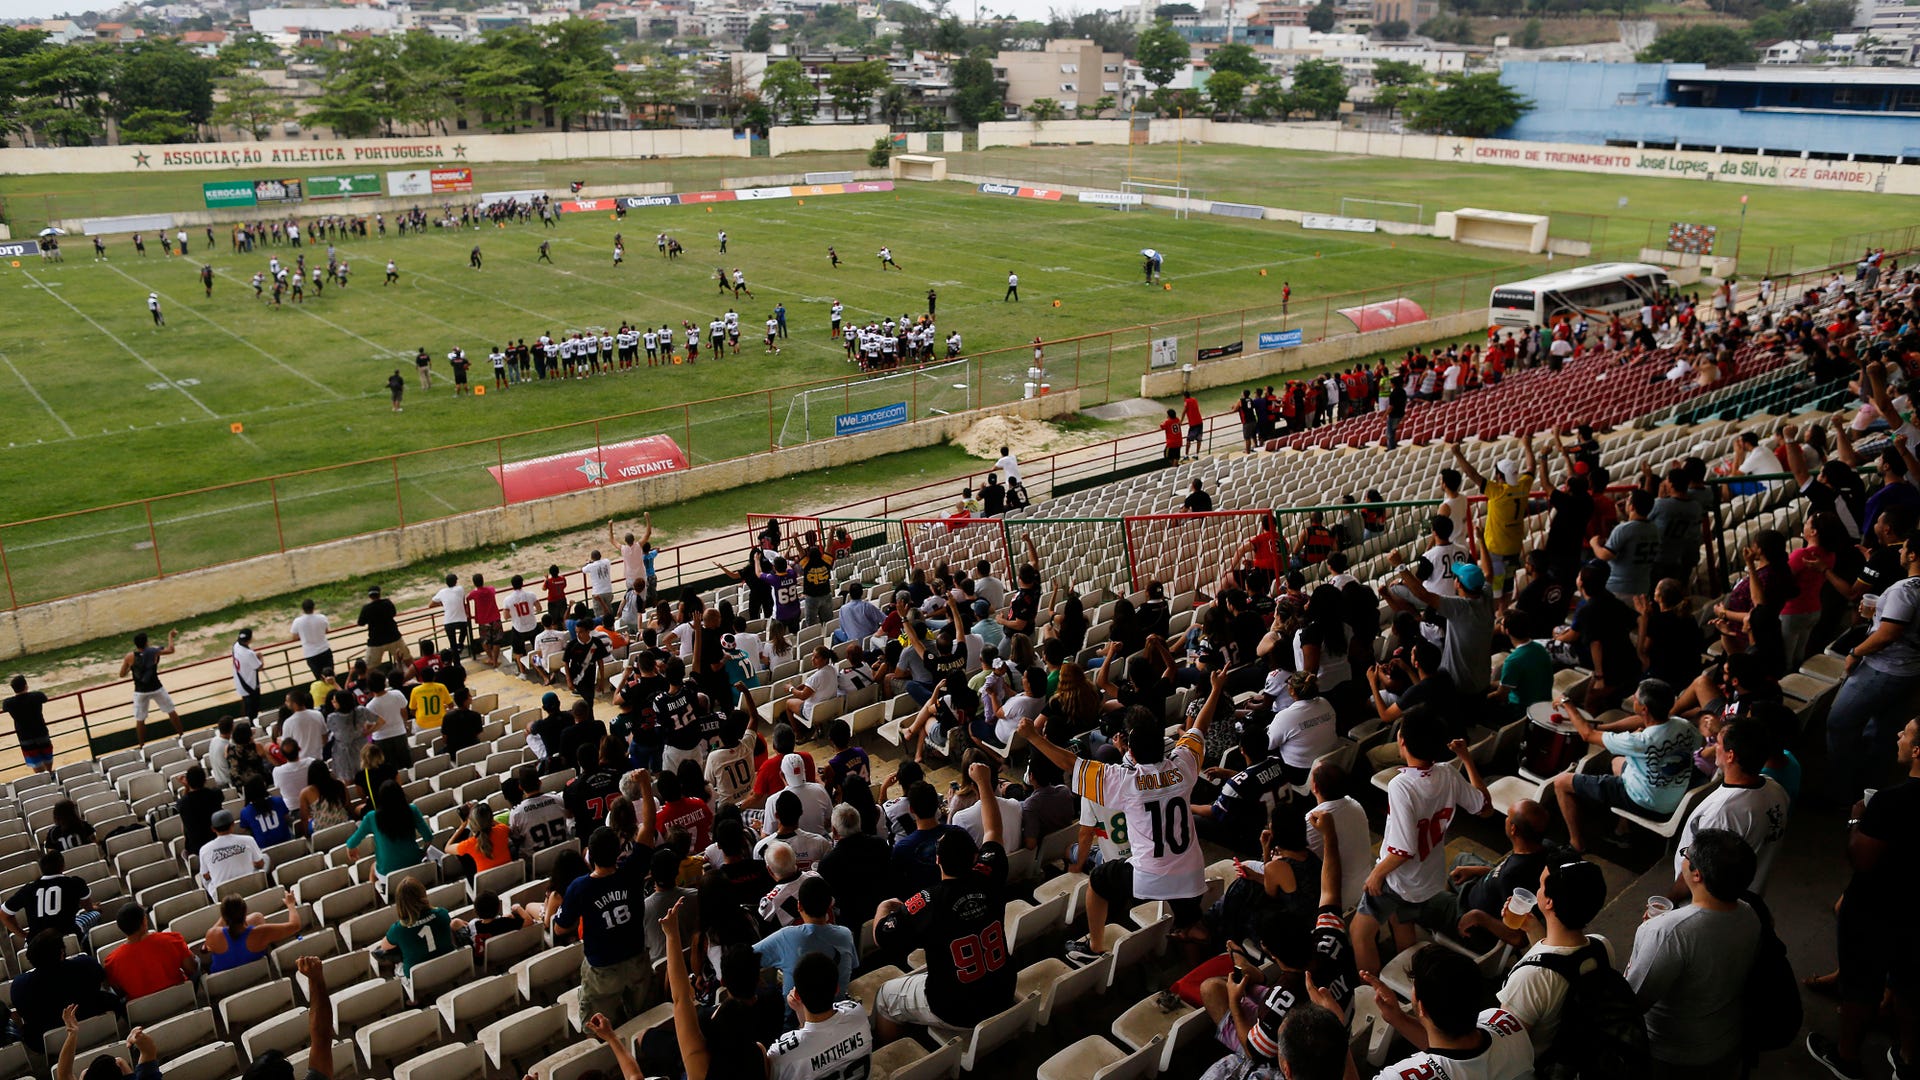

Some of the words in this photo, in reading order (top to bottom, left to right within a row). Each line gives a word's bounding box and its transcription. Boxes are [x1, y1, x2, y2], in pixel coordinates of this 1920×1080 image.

[164, 147, 262, 166] ASSOCIAÇÃO
[272, 147, 346, 162] ATLÉTICA
[354, 145, 443, 160] PORTUGUESA
[1476, 147, 1520, 160] CENTRO
[1525, 150, 1540, 162] DE
[1545, 153, 1631, 168] TREINAMENTO
[1636, 155, 1667, 170] José
[1669, 157, 1708, 176] Lopes
[1720, 160, 1737, 175] da
[1740, 161, 1778, 178] Silva
[627, 195, 672, 207] Qualicorp
[839, 405, 906, 428] WeLancer.com
[618, 458, 676, 478] VISITANTE
[777, 584, 798, 605] 69
[514, 601, 530, 617] 10
[422, 695, 441, 716] 10
[667, 696, 688, 712] BRADY
[671, 703, 697, 731] 12
[725, 758, 751, 790] 10
[1136, 767, 1184, 791] HOLMES
[1256, 763, 1283, 785] BRADY
[530, 816, 567, 851] 95
[1144, 796, 1190, 858] 10
[57, 833, 83, 851] 10
[36, 885, 62, 918] 10
[594, 889, 629, 910] DAMON
[602, 904, 632, 930] 18
[417, 924, 438, 953] 1
[950, 920, 1006, 984] 98
[1265, 985, 1295, 1018] 12
[811, 1032, 865, 1072] MATTHEWS
